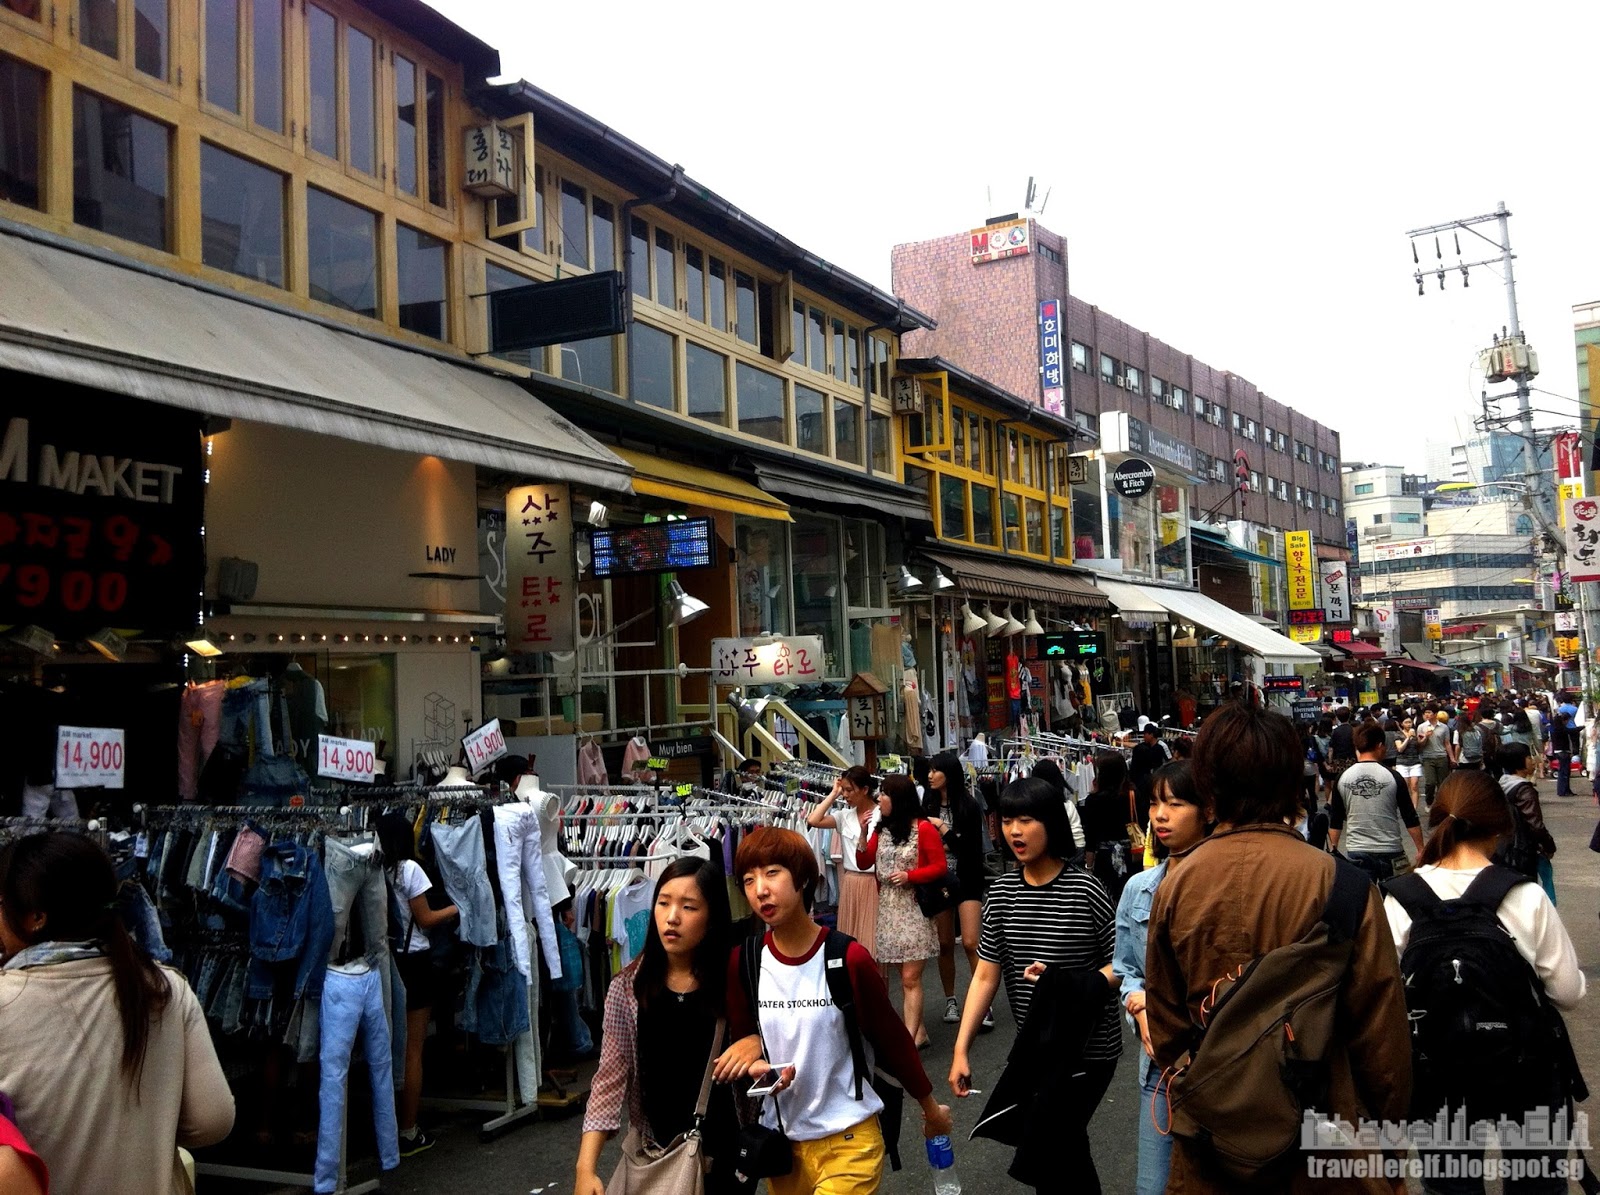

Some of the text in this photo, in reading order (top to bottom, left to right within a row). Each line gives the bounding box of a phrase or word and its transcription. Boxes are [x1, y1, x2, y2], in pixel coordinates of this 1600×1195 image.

[1044, 319, 1060, 384] 호미화방
[39, 445, 182, 504] MAKET
[1114, 469, 1153, 481] Abercrombie
[1129, 479, 1145, 488] Fitch
[426, 545, 456, 563] LADY
[0, 564, 128, 612] 900
[63, 740, 122, 772] 14,900
[323, 745, 374, 774] 14,900
[469, 728, 503, 764] 14,900
[659, 742, 692, 756] Muy bien
